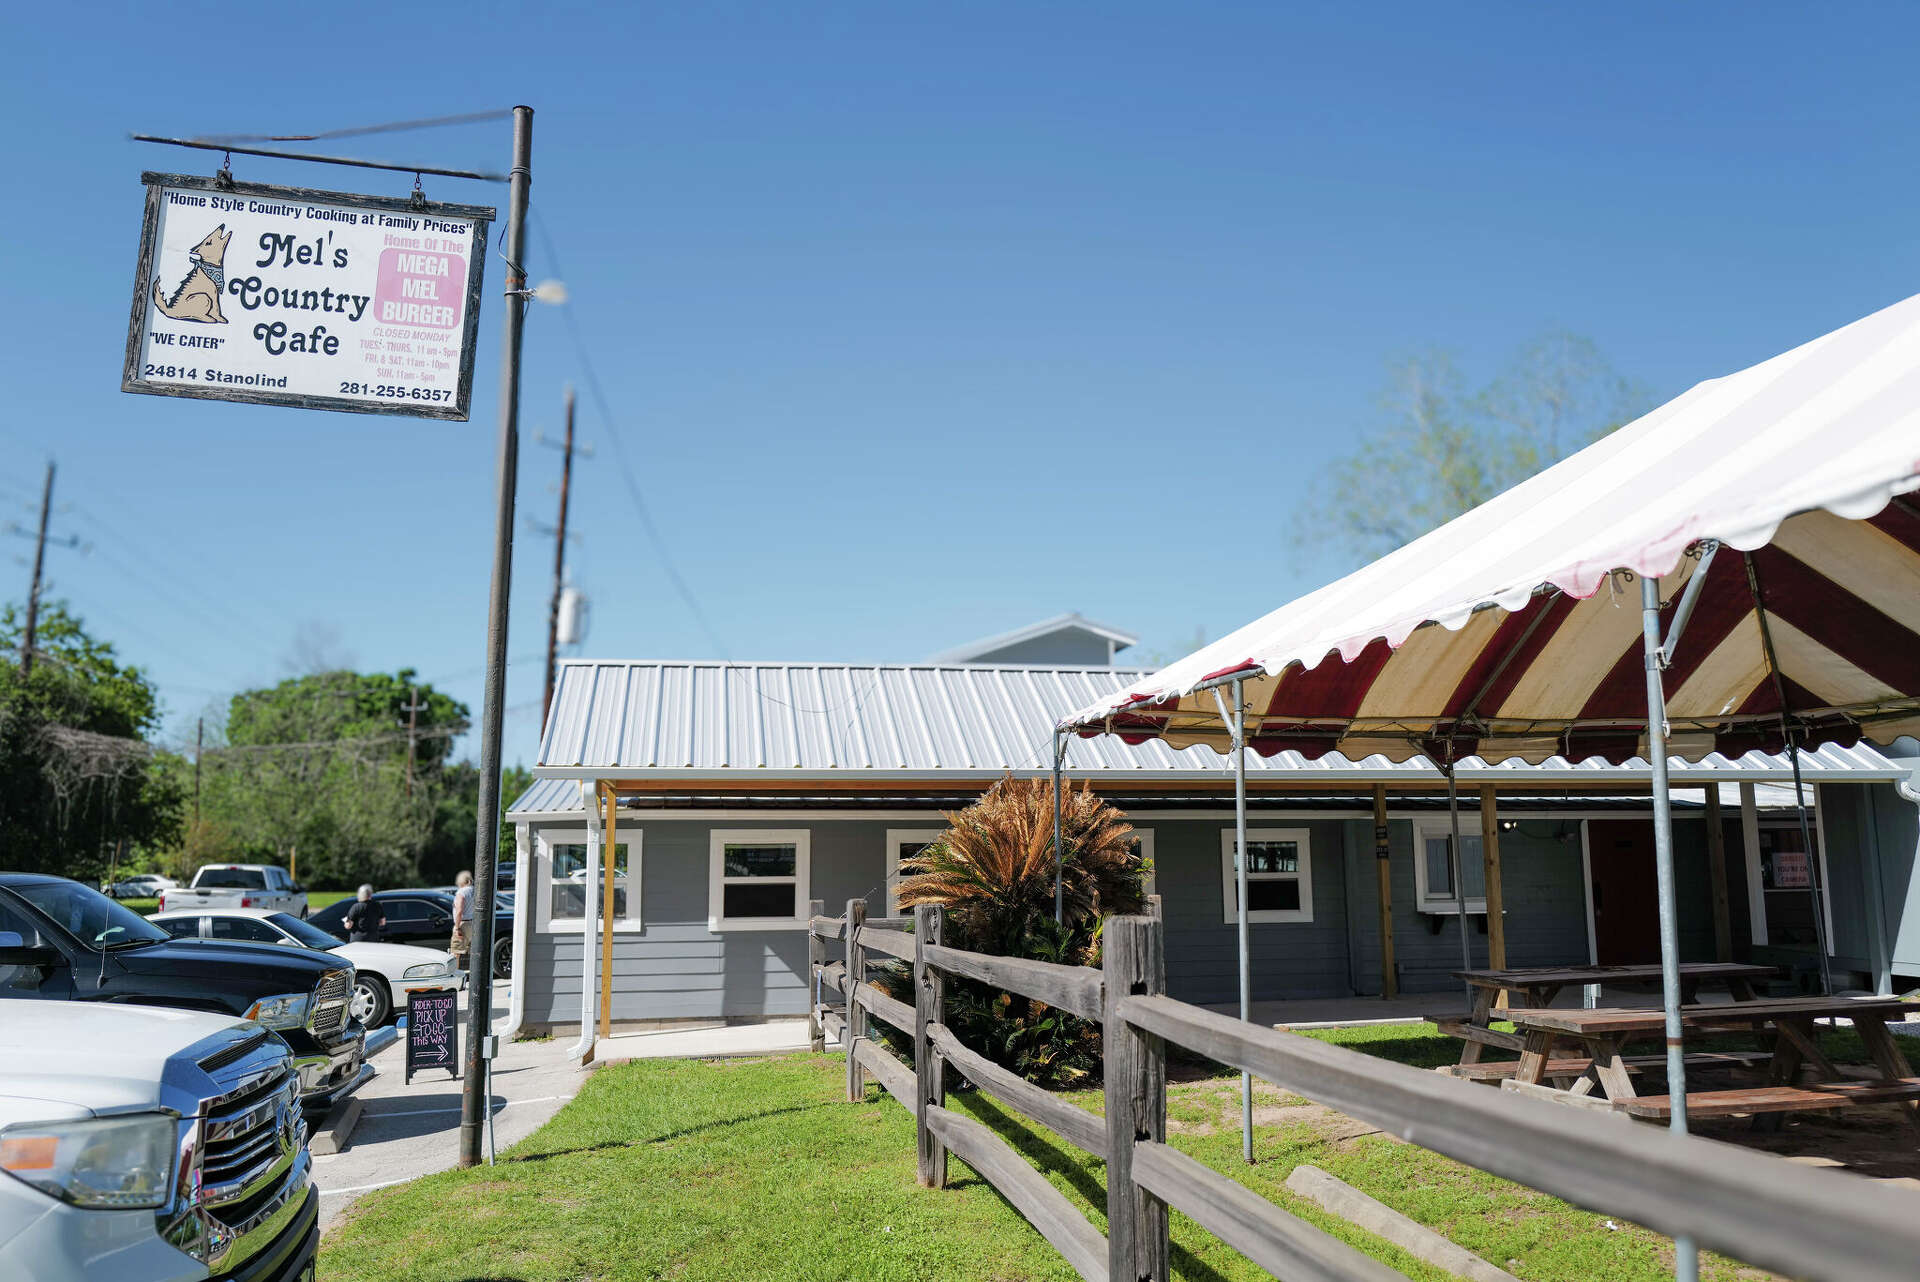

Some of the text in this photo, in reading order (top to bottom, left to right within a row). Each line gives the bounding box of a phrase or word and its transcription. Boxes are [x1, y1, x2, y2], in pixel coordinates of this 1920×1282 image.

[164, 192, 472, 234] "Home Style Country Cooking at Family Prices"
[256, 230, 348, 268] Mel's
[384, 234, 464, 253] Home Of The
[396, 254, 449, 278] MEGA
[228, 276, 370, 322] Country
[402, 278, 439, 300] MEL
[382, 301, 454, 326] BURGER
[150, 332, 225, 350] "WE CATER"
[253, 321, 339, 356] Cafe
[373, 327, 451, 344] CLOSED MONDAY
[380, 354, 386, 364] &
[144, 364, 288, 388] 24814 Stanolind
[340, 382, 452, 402] 281-255-6357
[415, 1009, 447, 1023] PICK UP
[430, 1034, 448, 1044] WAY
